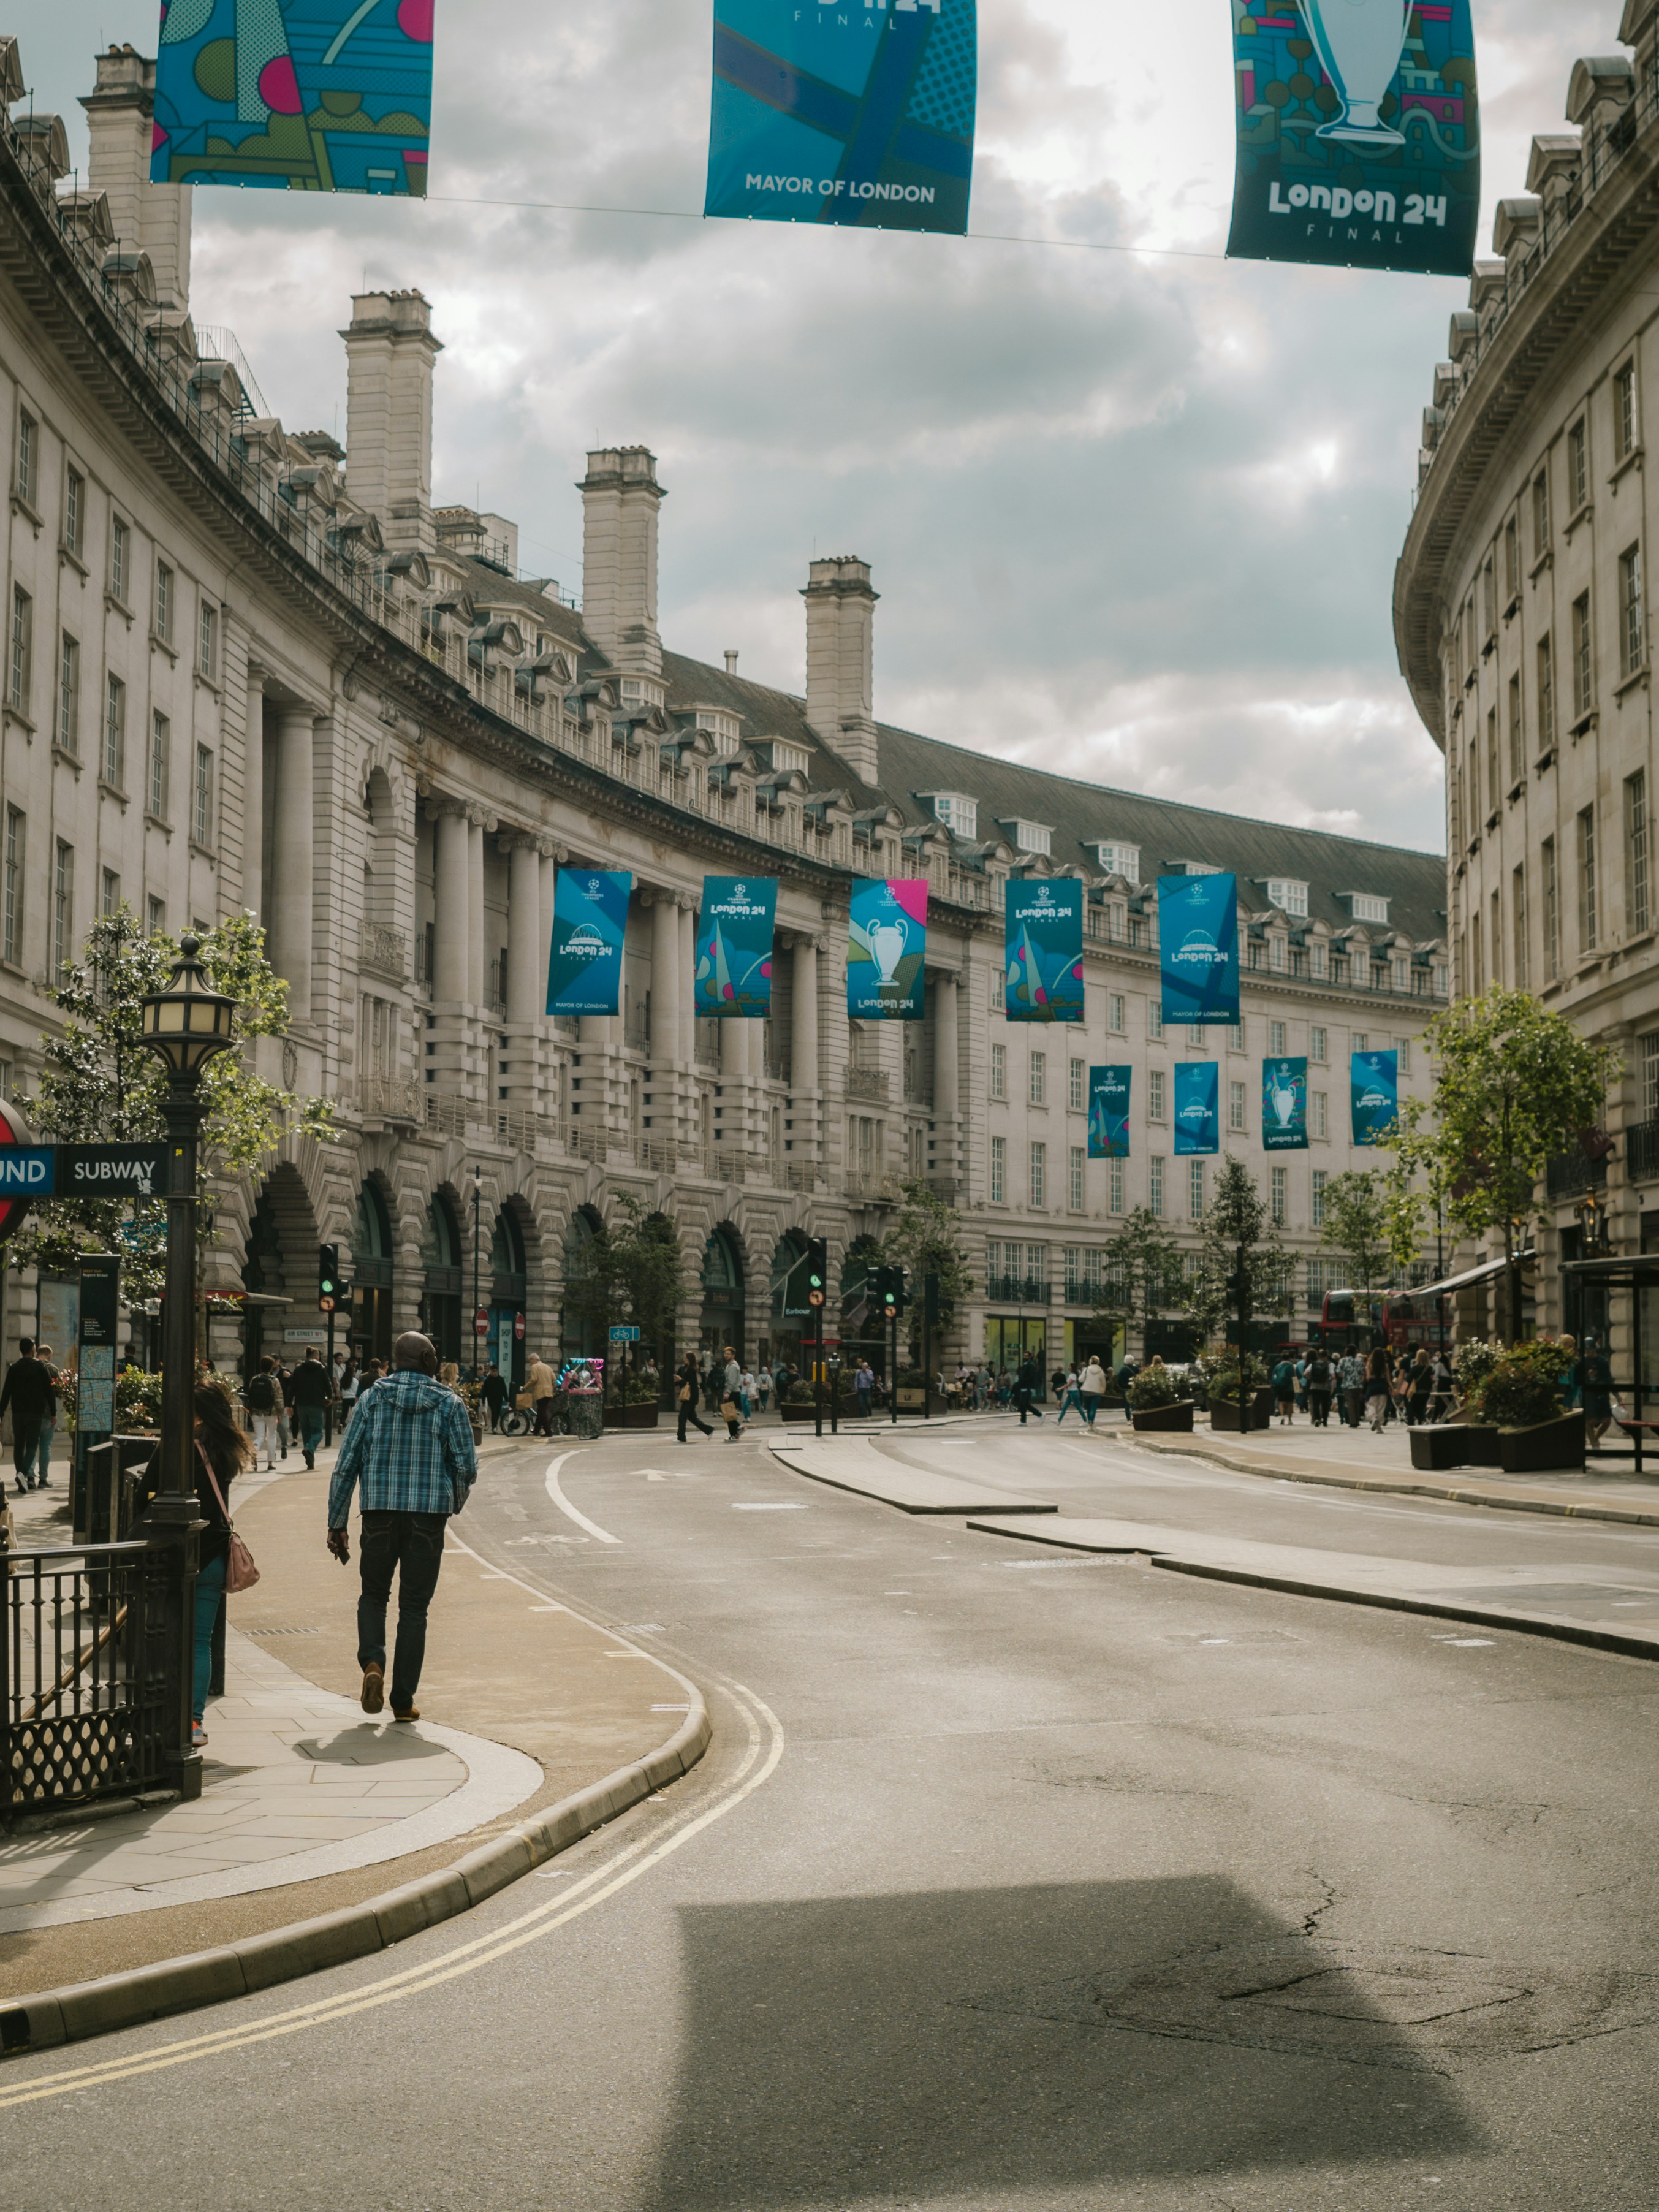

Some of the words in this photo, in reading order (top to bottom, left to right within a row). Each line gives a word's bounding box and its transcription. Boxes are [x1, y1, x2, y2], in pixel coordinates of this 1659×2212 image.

[794, 10, 897, 30] FINAL
[745, 173, 813, 194] MAYOR
[818, 179, 845, 197] OF
[849, 180, 935, 204] LONDON
[1402, 194, 1447, 227] 24
[1307, 223, 1403, 244] FINAL
[751, 906, 766, 916] 24
[1057, 907, 1072, 918] 24
[598, 946, 613, 956] 24
[1213, 952, 1229, 962] 24
[899, 999, 914, 1009] 24
[0, 1160, 46, 1182] ND
[74, 1161, 156, 1180] SUBWAY
[503, 1340, 508, 1349] TO
